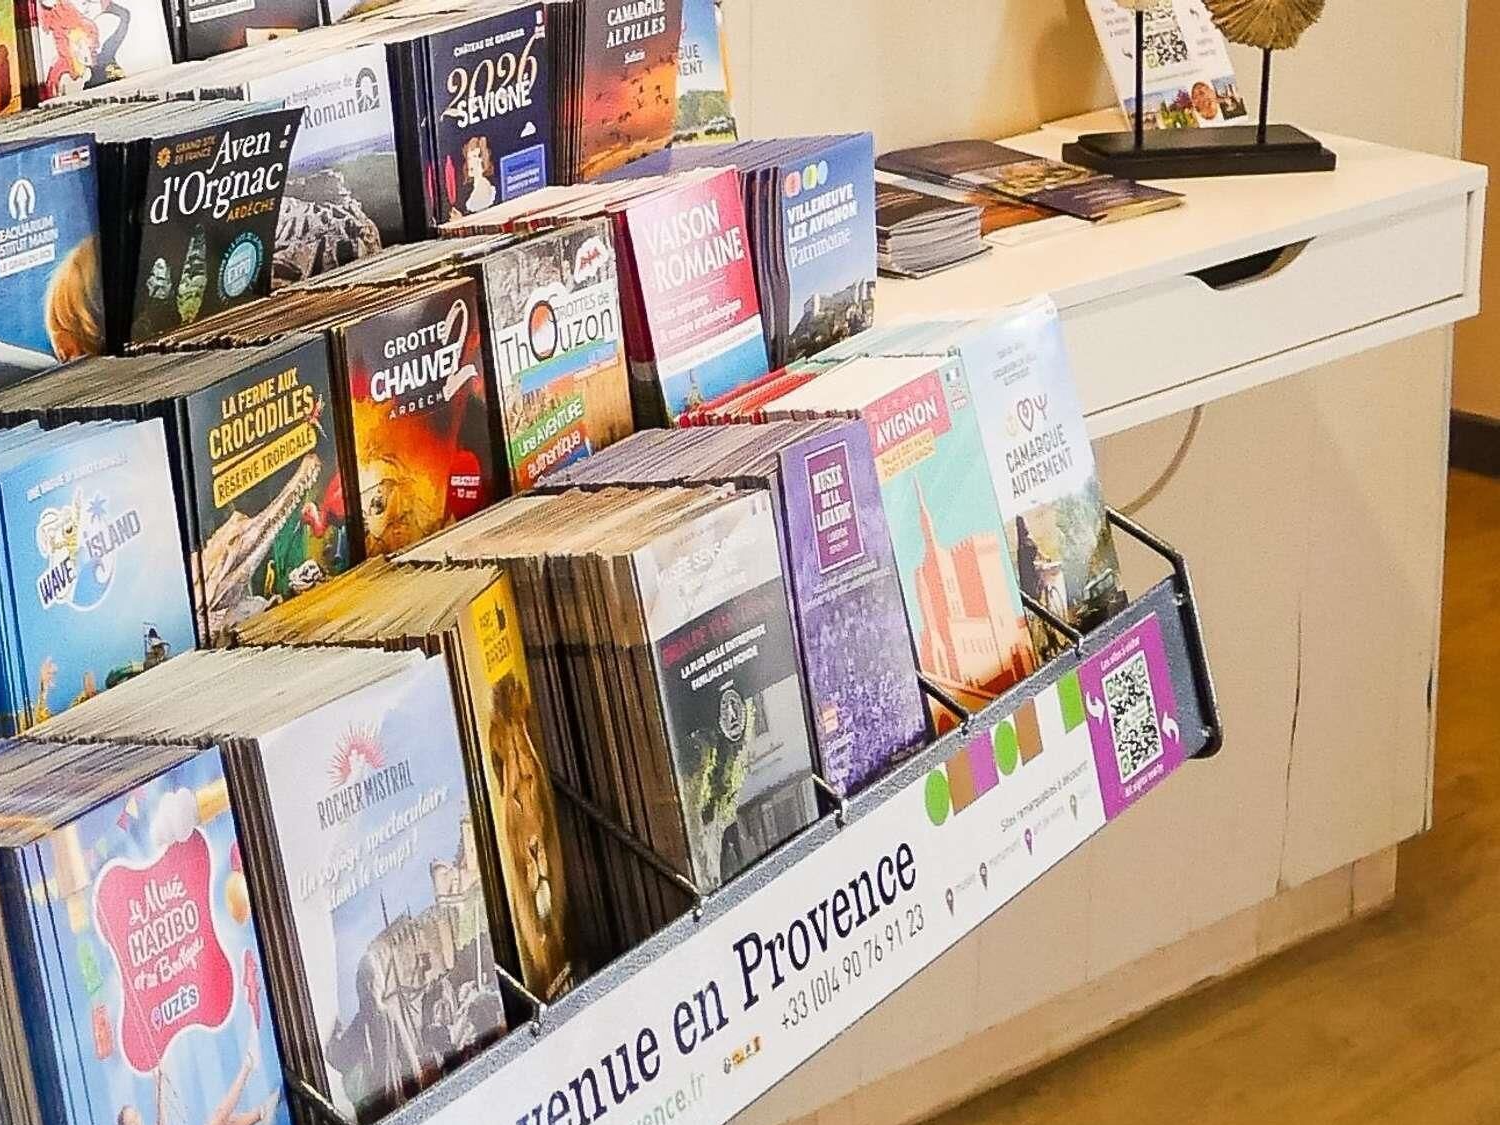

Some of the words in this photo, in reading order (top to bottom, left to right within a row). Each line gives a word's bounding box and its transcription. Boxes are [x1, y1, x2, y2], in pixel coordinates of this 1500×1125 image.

[606, 16, 666, 49] ALPILLES
[607, 0, 665, 26] CAMARGUE
[441, 34, 538, 121] 2026
[206, 130, 271, 175] Aven
[150, 162, 284, 225] d'Orgnac
[787, 182, 854, 225] VILLENEUVE
[643, 199, 722, 256] VAISON
[652, 226, 746, 293] ROMAINE
[384, 320, 446, 359] GROTTE
[221, 394, 237, 420] LA
[238, 377, 276, 413] FERME
[277, 367, 299, 394] AUX
[370, 342, 461, 402] CHAUVET
[208, 384, 314, 461] CROCODILES
[876, 396, 938, 450] AVIGNON
[1005, 423, 1068, 474] CAMARGUE
[38, 555, 76, 605] WAVE
[315, 785, 367, 832] ROCHER
[363, 758, 415, 809] MISTRAL
[129, 901, 199, 967] HARIBO
[673, 980, 730, 1055] en
[732, 842, 917, 1012] Provence
[781, 990, 809, 1030] +33
[810, 966, 841, 1012] (0)4
[843, 950, 862, 984] 90
[863, 933, 884, 968] 76
[885, 918, 903, 953] 91
[905, 903, 925, 938] 23
[162, 986, 199, 1021] UZÈS
